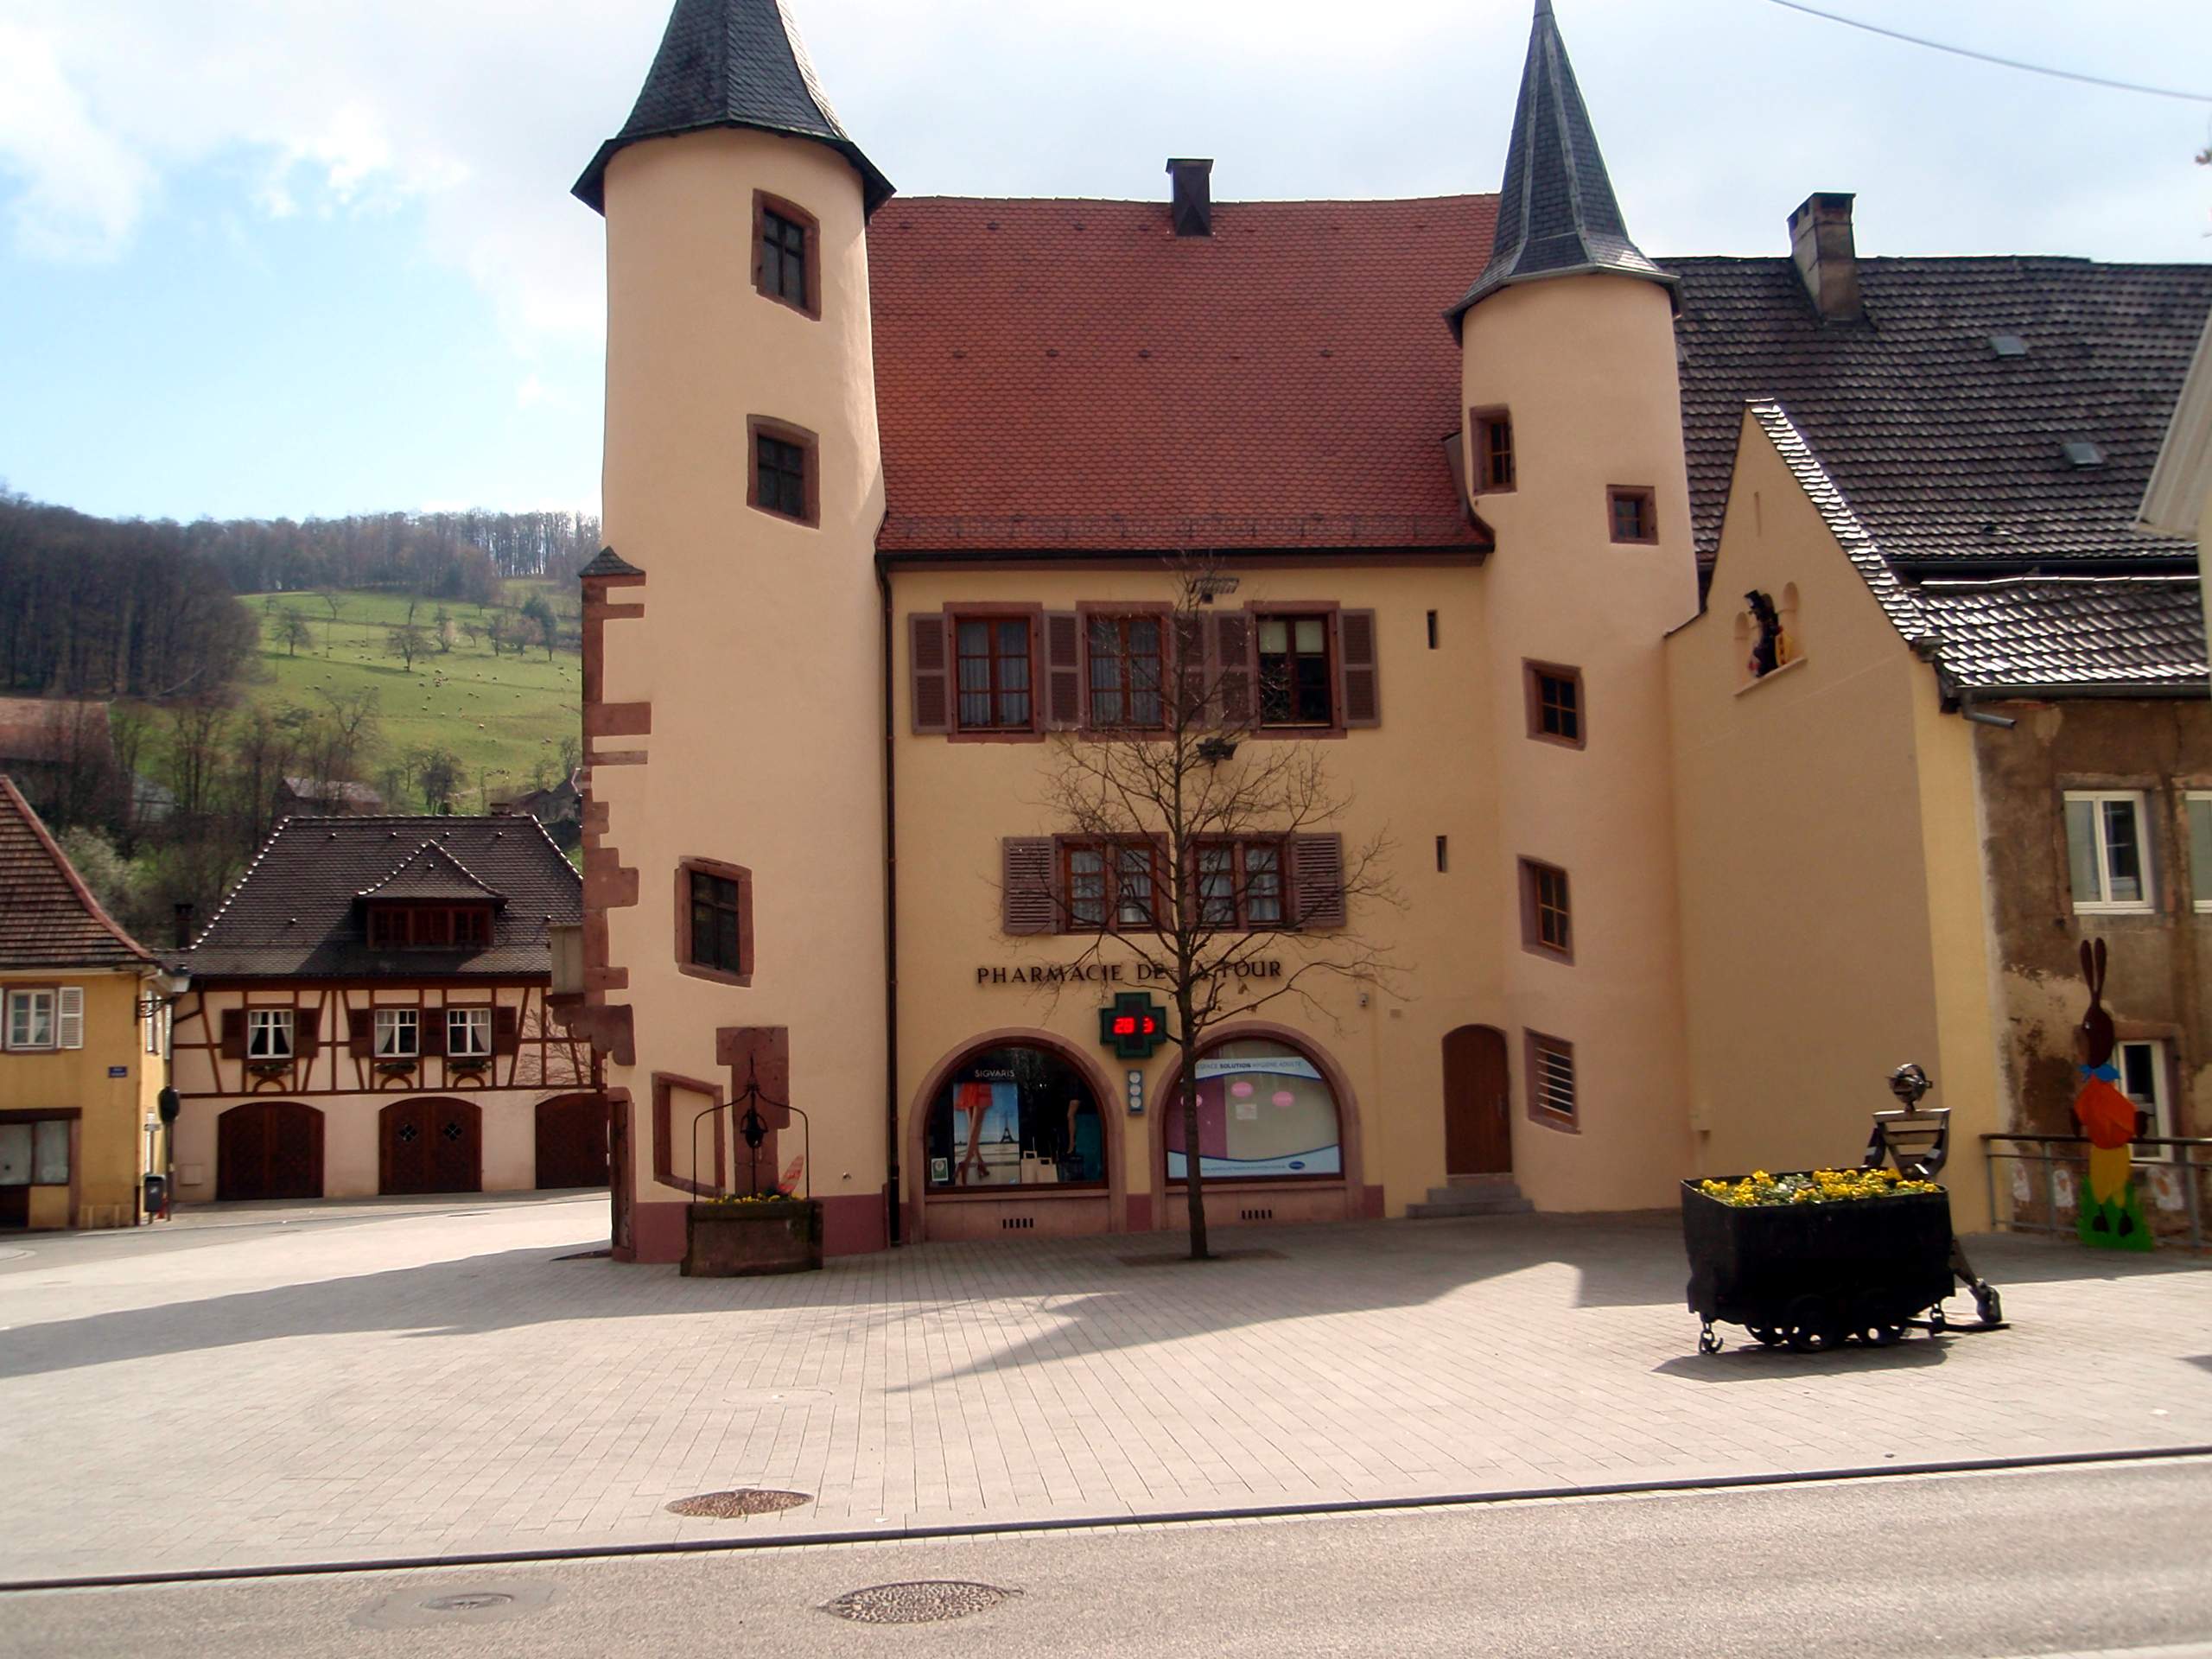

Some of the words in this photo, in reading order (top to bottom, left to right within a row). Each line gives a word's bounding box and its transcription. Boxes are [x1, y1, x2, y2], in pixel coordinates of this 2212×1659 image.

[976, 963, 1122, 983] PHARMACIE
[1138, 963, 1166, 980] DE
[1220, 961, 1281, 978] TOUR
[975, 1069, 1014, 1077] SIGVARIS
